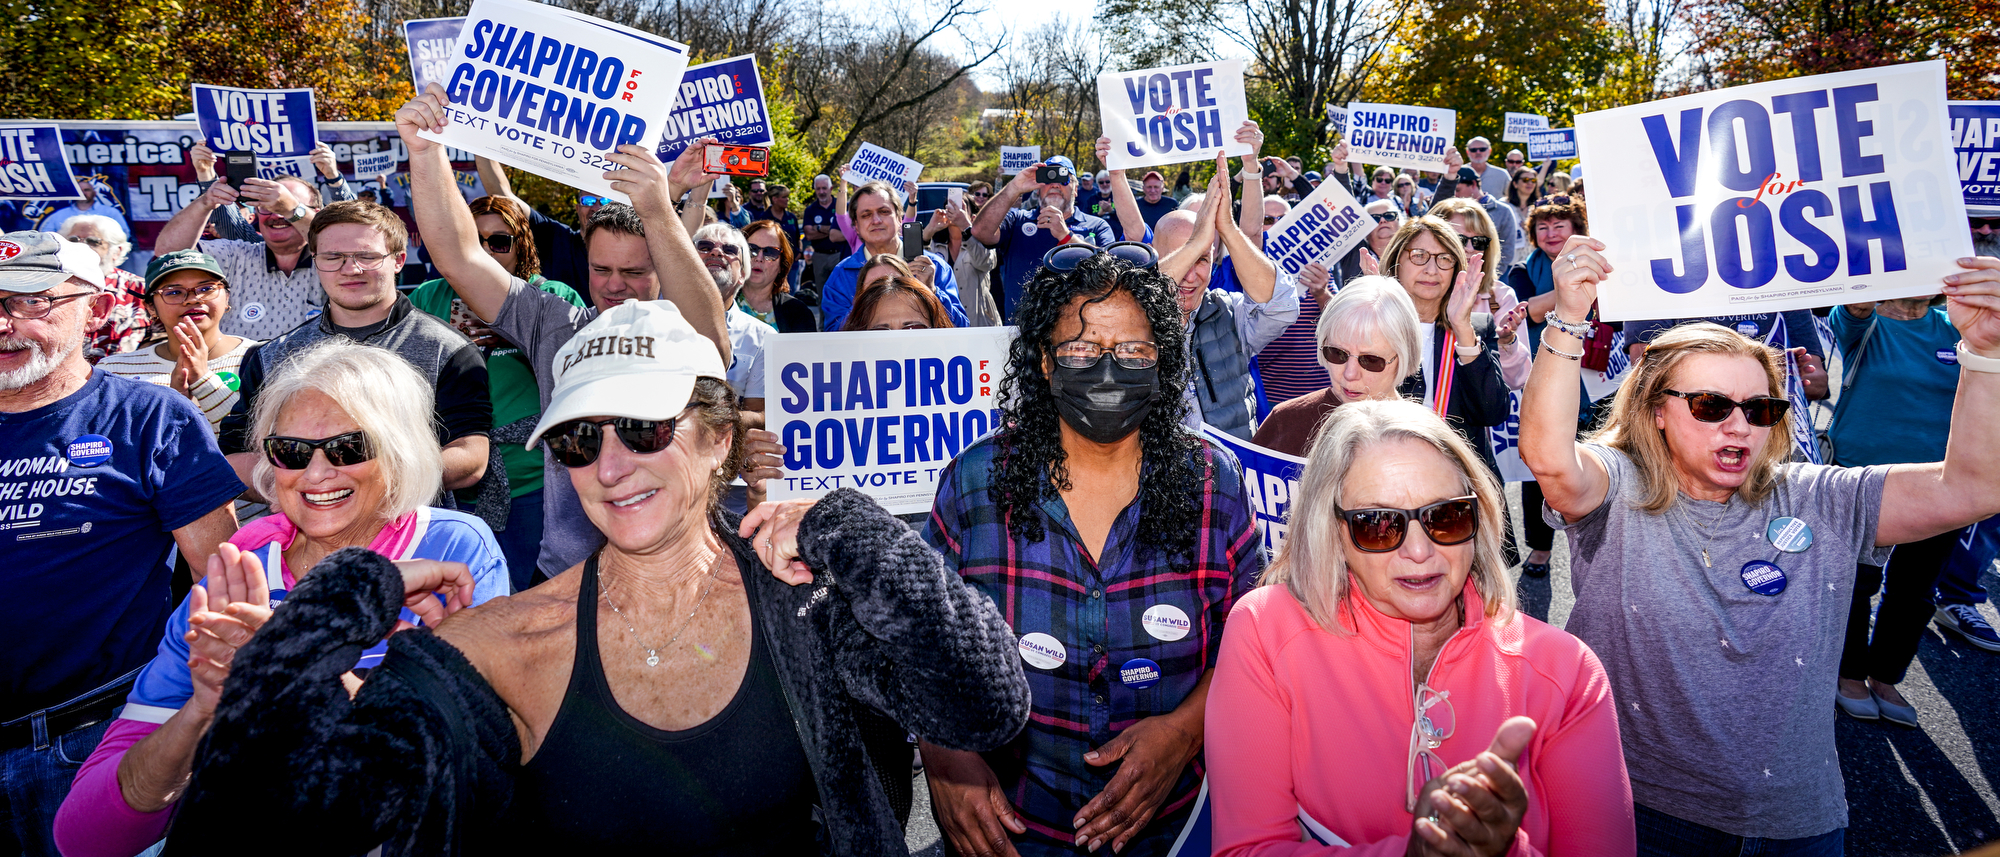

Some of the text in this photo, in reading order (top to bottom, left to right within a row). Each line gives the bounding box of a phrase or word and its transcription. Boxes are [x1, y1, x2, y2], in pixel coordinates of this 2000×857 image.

[464, 18, 625, 101] SHAPIRO
[621, 69, 642, 102] FOR
[671, 74, 735, 111] APIRO
[733, 74, 743, 95] FOR
[1123, 68, 1217, 115] VOTE
[211, 90, 289, 123] VOTE
[446, 62, 647, 154] GOVERNOR
[1158, 105, 1183, 121] for
[240, 118, 260, 127] for
[662, 98, 762, 142] OVERNOR
[1353, 111, 1430, 133] SHAPIRO
[1508, 117, 1539, 126] SHAPIRO
[213, 121, 294, 154] JOSH
[443, 106, 489, 130] TEXT
[494, 122, 546, 150] VOTE
[551, 141, 576, 159] TO
[660, 141, 681, 154] EXT
[719, 131, 733, 140] TO
[735, 125, 763, 137] 32210
[1127, 109, 1223, 157] JOSH
[1350, 129, 1447, 155] GOVERNOR
[1530, 133, 1565, 143] SHAPIRO
[1640, 83, 1886, 198] VOTE
[0, 129, 41, 161] TE
[64, 136, 192, 165] merica'
[1003, 152, 1032, 160] SHAPIRO
[1350, 147, 1372, 155] TEXT
[1375, 150, 1400, 158] VOTE
[1531, 141, 1574, 153] GOVERNOR
[357, 155, 389, 166] SHAPIRO
[357, 161, 395, 174] GOVERNOR
[858, 148, 905, 175] SHAPIRO
[394, 170, 475, 187] TEER
[1736, 172, 1807, 209] for
[1323, 197, 1336, 211] FOR
[1268, 203, 1329, 261] HAPIRO
[1282, 205, 1360, 274] OVERNOR
[1332, 240, 1342, 251] TO
[1343, 219, 1365, 241] 32210
[1650, 181, 1907, 295] JOSH
[1799, 287, 1843, 295] PENNSYLVANIA
[560, 336, 655, 376] LEHIGH
[781, 355, 973, 415] SHAPIRO
[979, 360, 991, 397] FOR
[71, 441, 103, 451] SHAPIRO
[71, 447, 110, 457] GOVERNOR
[0, 456, 70, 477] WOMAN
[27, 477, 98, 499] HOUSE
[784, 475, 845, 491] TEXT
[852, 470, 917, 488] VOTE
[1742, 565, 1771, 581] SHAPIRO
[1746, 570, 1782, 587] GOVERNOR
[1144, 615, 1167, 623] SUSAN
[1169, 618, 1188, 626] WILD
[1020, 639, 1044, 651] SUSAN
[1045, 648, 1064, 658] WILD
[1120, 667, 1150, 677] SHAPIRO
[1122, 671, 1159, 683] GOVERNOR
